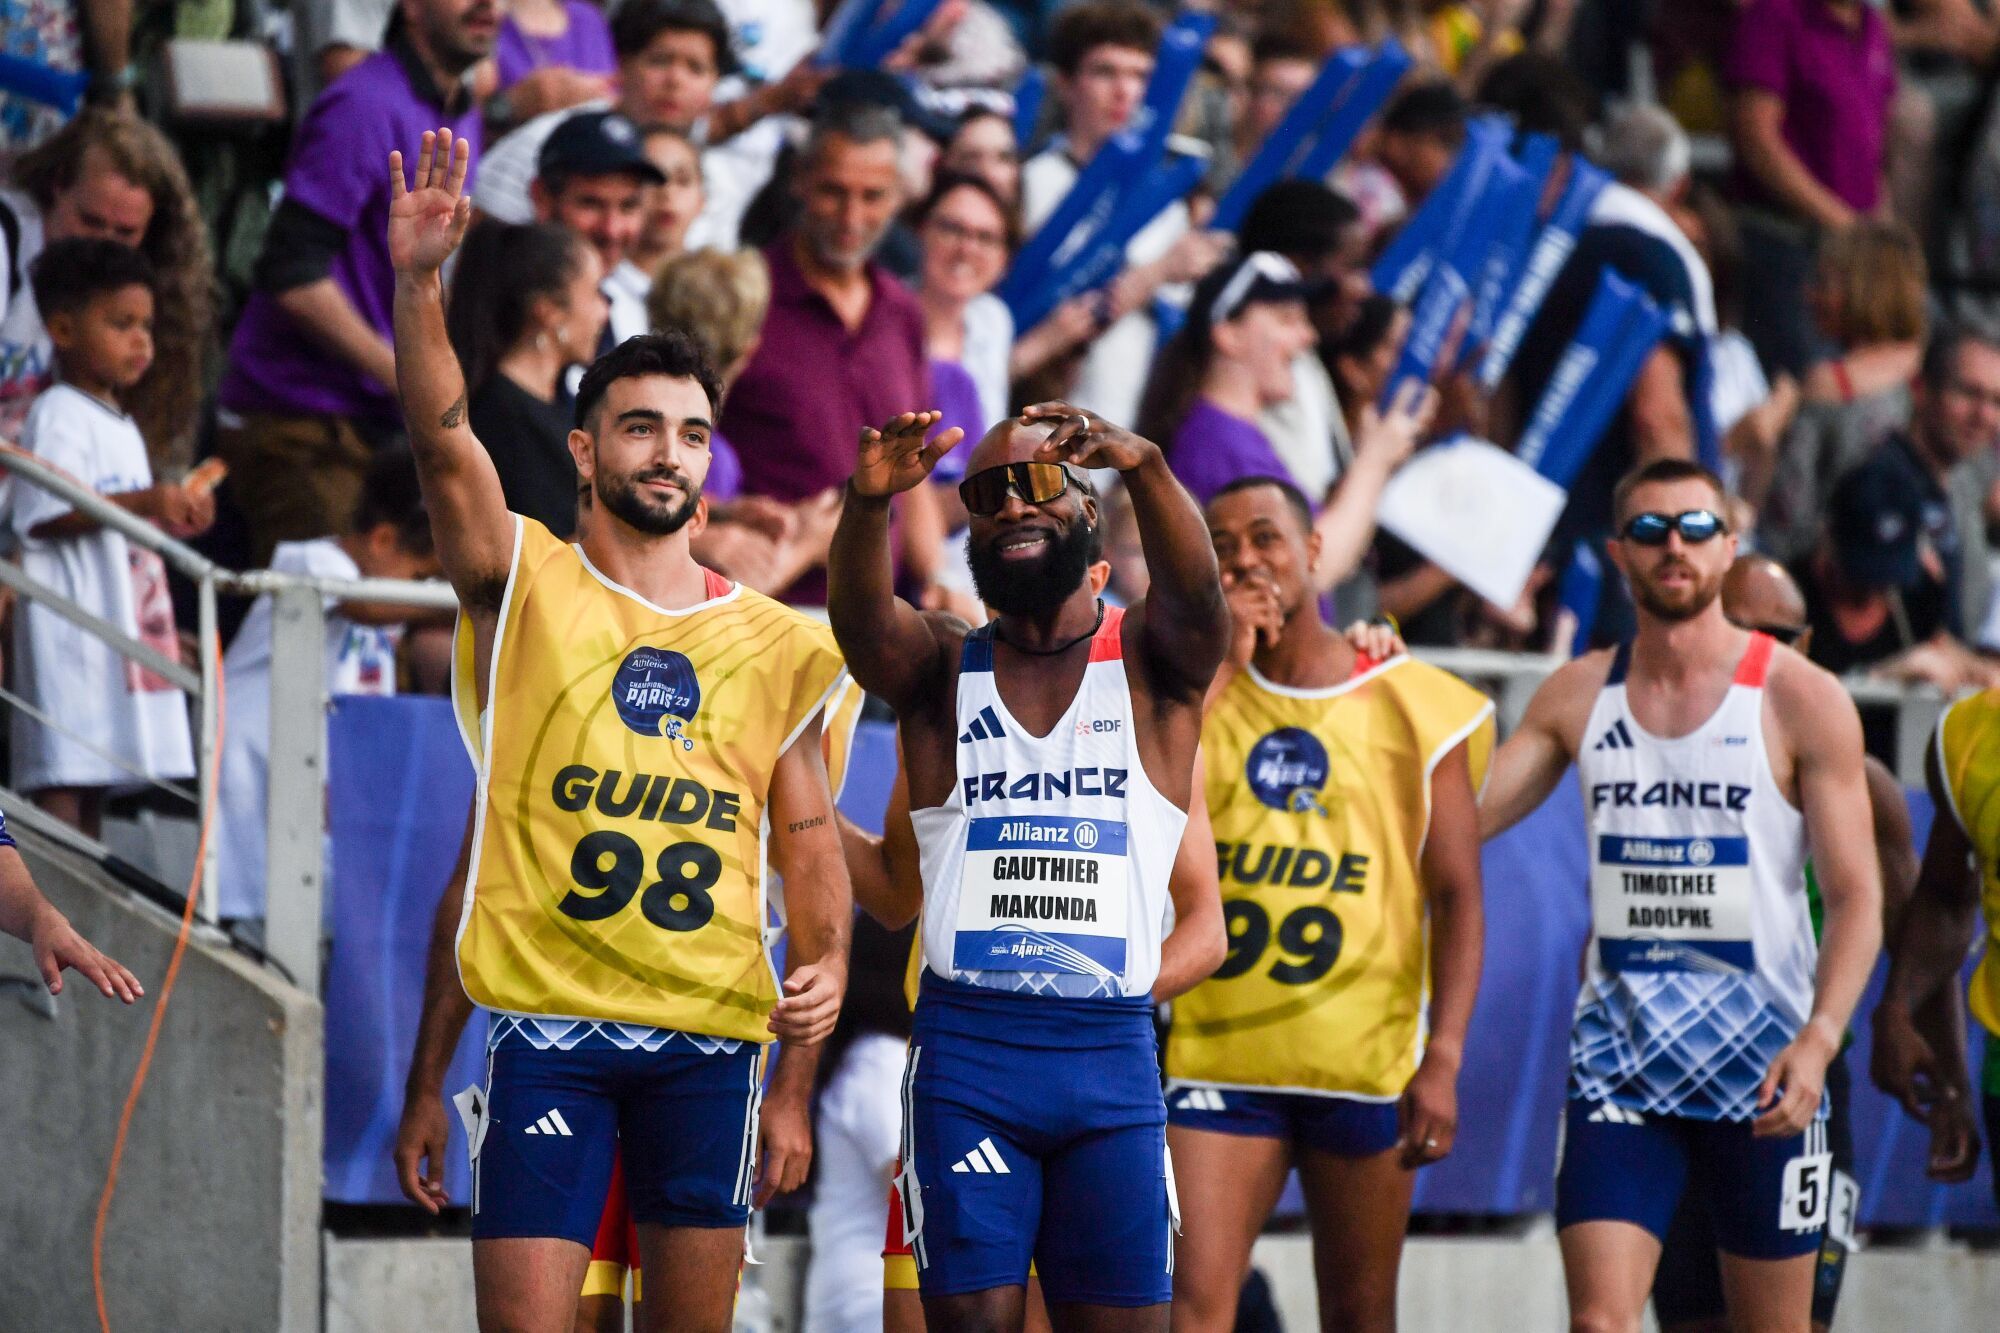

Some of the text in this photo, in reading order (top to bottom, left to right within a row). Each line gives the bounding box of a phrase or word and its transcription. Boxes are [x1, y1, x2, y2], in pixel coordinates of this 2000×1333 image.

[632, 659, 669, 669] Athletics
[552, 764, 741, 833] GUIDE
[963, 767, 1128, 806] FRANCE
[1593, 782, 1752, 811] FRANCE
[997, 822, 1069, 843] Allianz
[1621, 841, 1685, 862] Allianz
[556, 830, 723, 932] 98
[993, 856, 1099, 884] GAUTHIER
[1621, 872, 1717, 895] TIMOTHEE
[989, 894, 1098, 922] MAKUNDA
[1627, 906, 1713, 929] ADOLPHE
[1208, 897, 1344, 986] 99
[1798, 1165, 1819, 1218] 5
